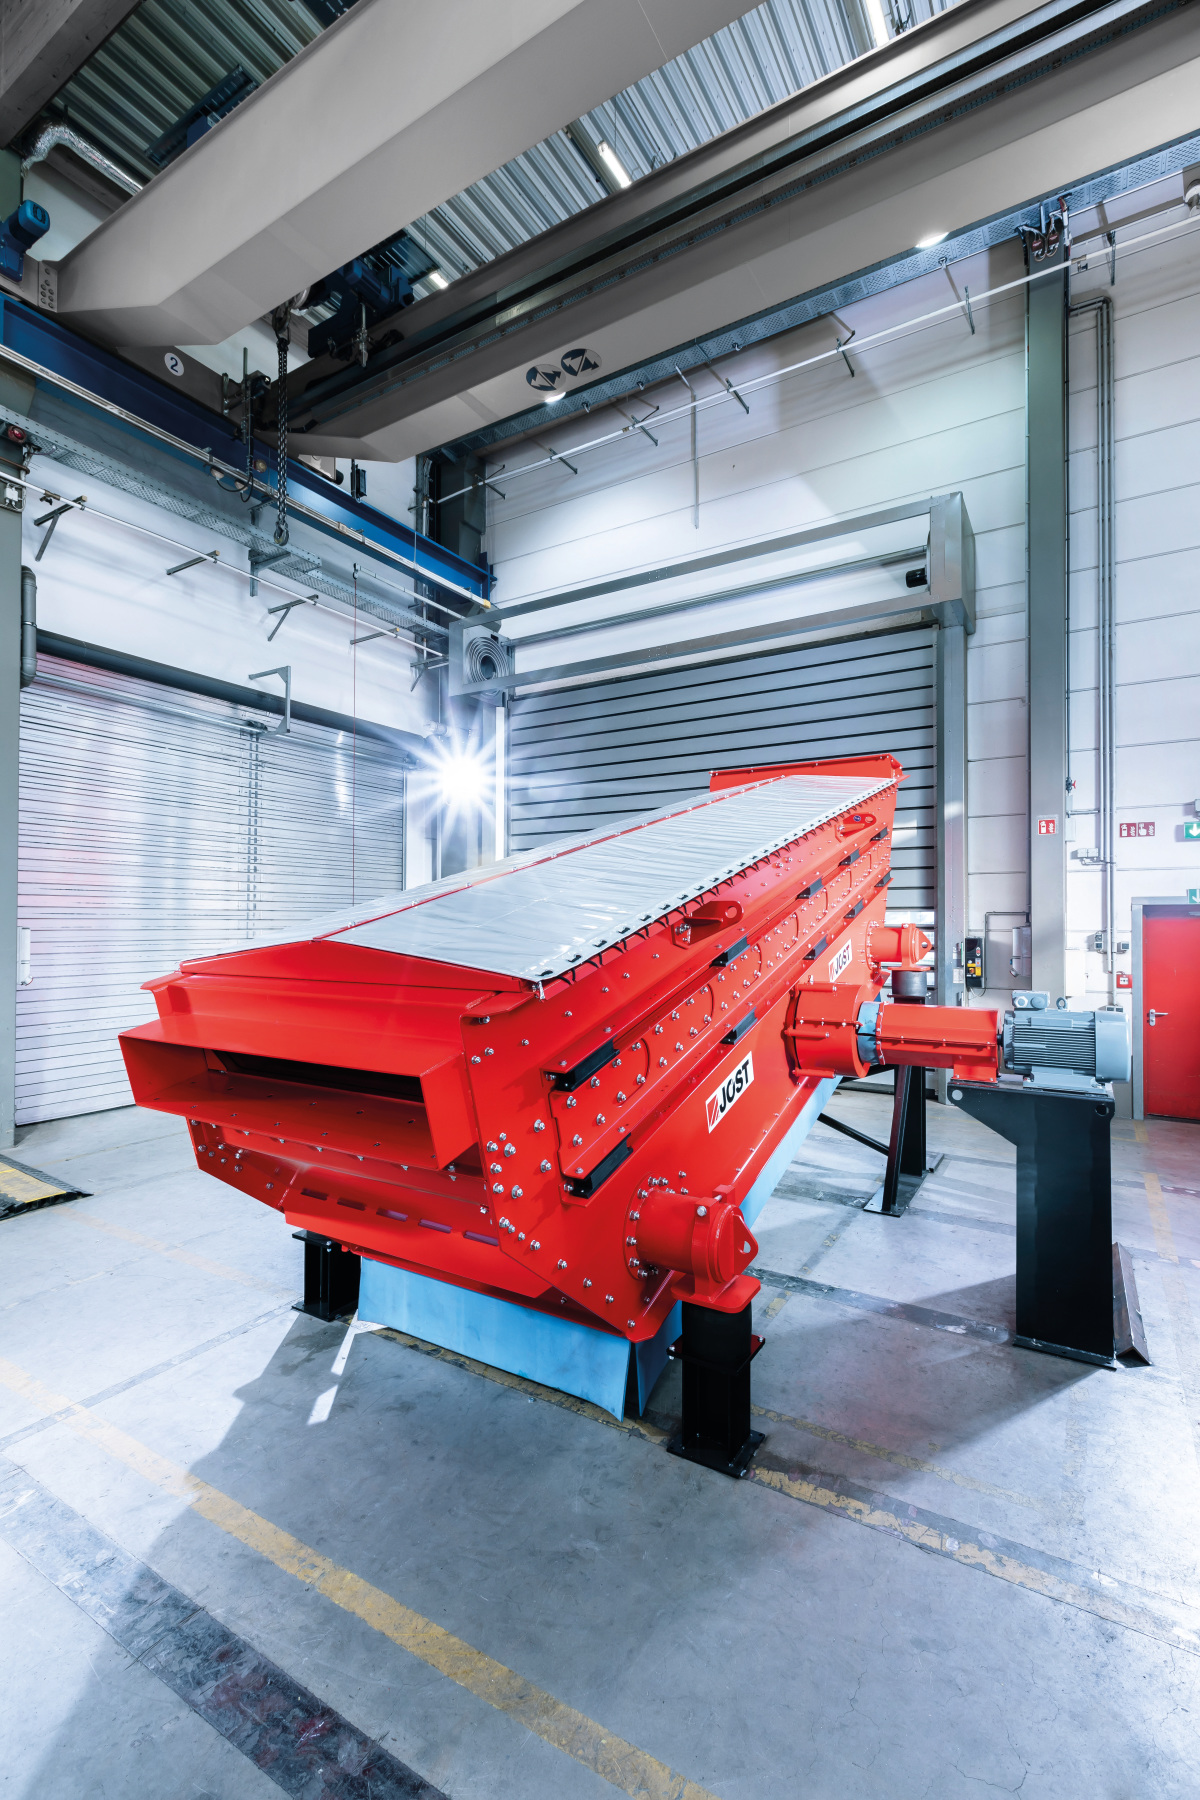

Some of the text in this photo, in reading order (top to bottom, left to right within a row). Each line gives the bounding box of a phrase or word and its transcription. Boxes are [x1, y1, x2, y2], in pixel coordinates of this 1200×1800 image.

[170, 356, 179, 373] 2
[835, 944, 850, 975] JOST
[719, 1059, 749, 1113] JOST
